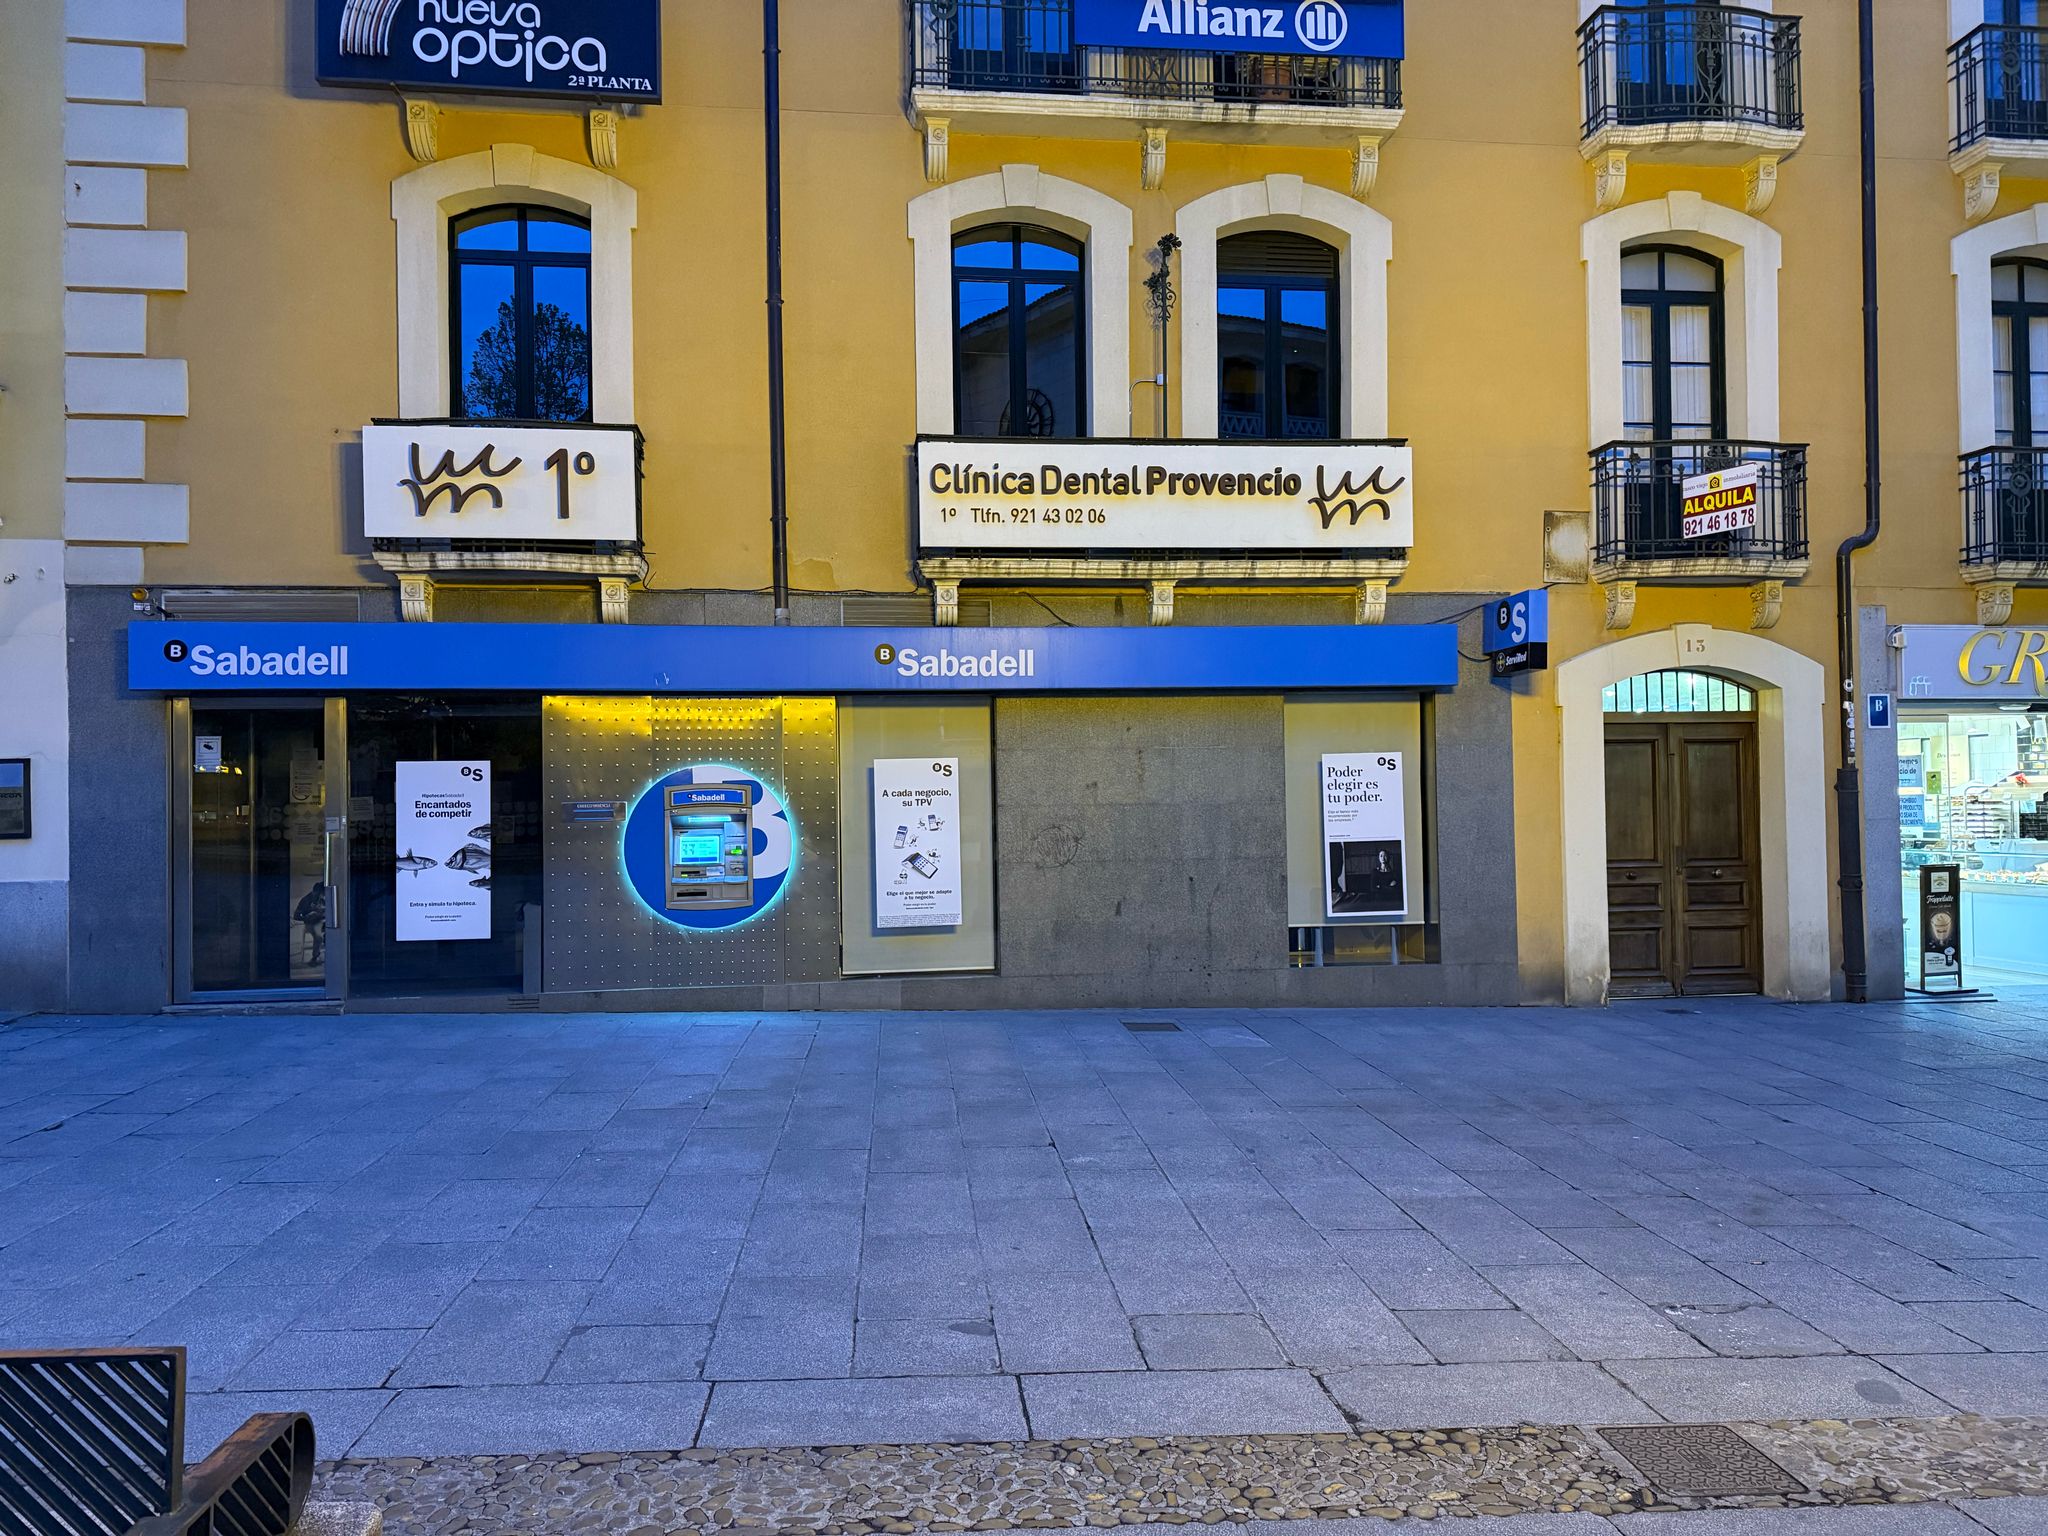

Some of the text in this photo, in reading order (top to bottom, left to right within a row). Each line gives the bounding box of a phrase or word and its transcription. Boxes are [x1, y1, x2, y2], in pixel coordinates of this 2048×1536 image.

[419, 0, 541, 28] nueva
[1138, 0, 1284, 39] Allianz
[412, 27, 607, 83] optica
[587, 76, 653, 91] PLANTA
[544, 448, 595, 519] 1º
[929, 463, 1302, 497] Clínica Dental Provencio
[1683, 486, 1755, 515] ALQUILA
[941, 508, 1106, 524] 1º Tlfn. 921 43 02 06
[1684, 508, 1754, 536] 921 46 18 78
[1511, 602, 1526, 643] S
[1687, 639, 1705, 652] 13
[190, 644, 348, 676] Sabadell
[897, 648, 1034, 677] Sabadell
[1327, 765, 1363, 778] Poder
[882, 788, 951, 798] A cada negocio,
[1327, 778, 1378, 793] elegir es
[415, 800, 471, 809] Encantados
[692, 794, 725, 802] Sabadell
[915, 798, 932, 806] TPV
[1328, 790, 1382, 806] tu poder.
[415, 809, 472, 819] de competir
